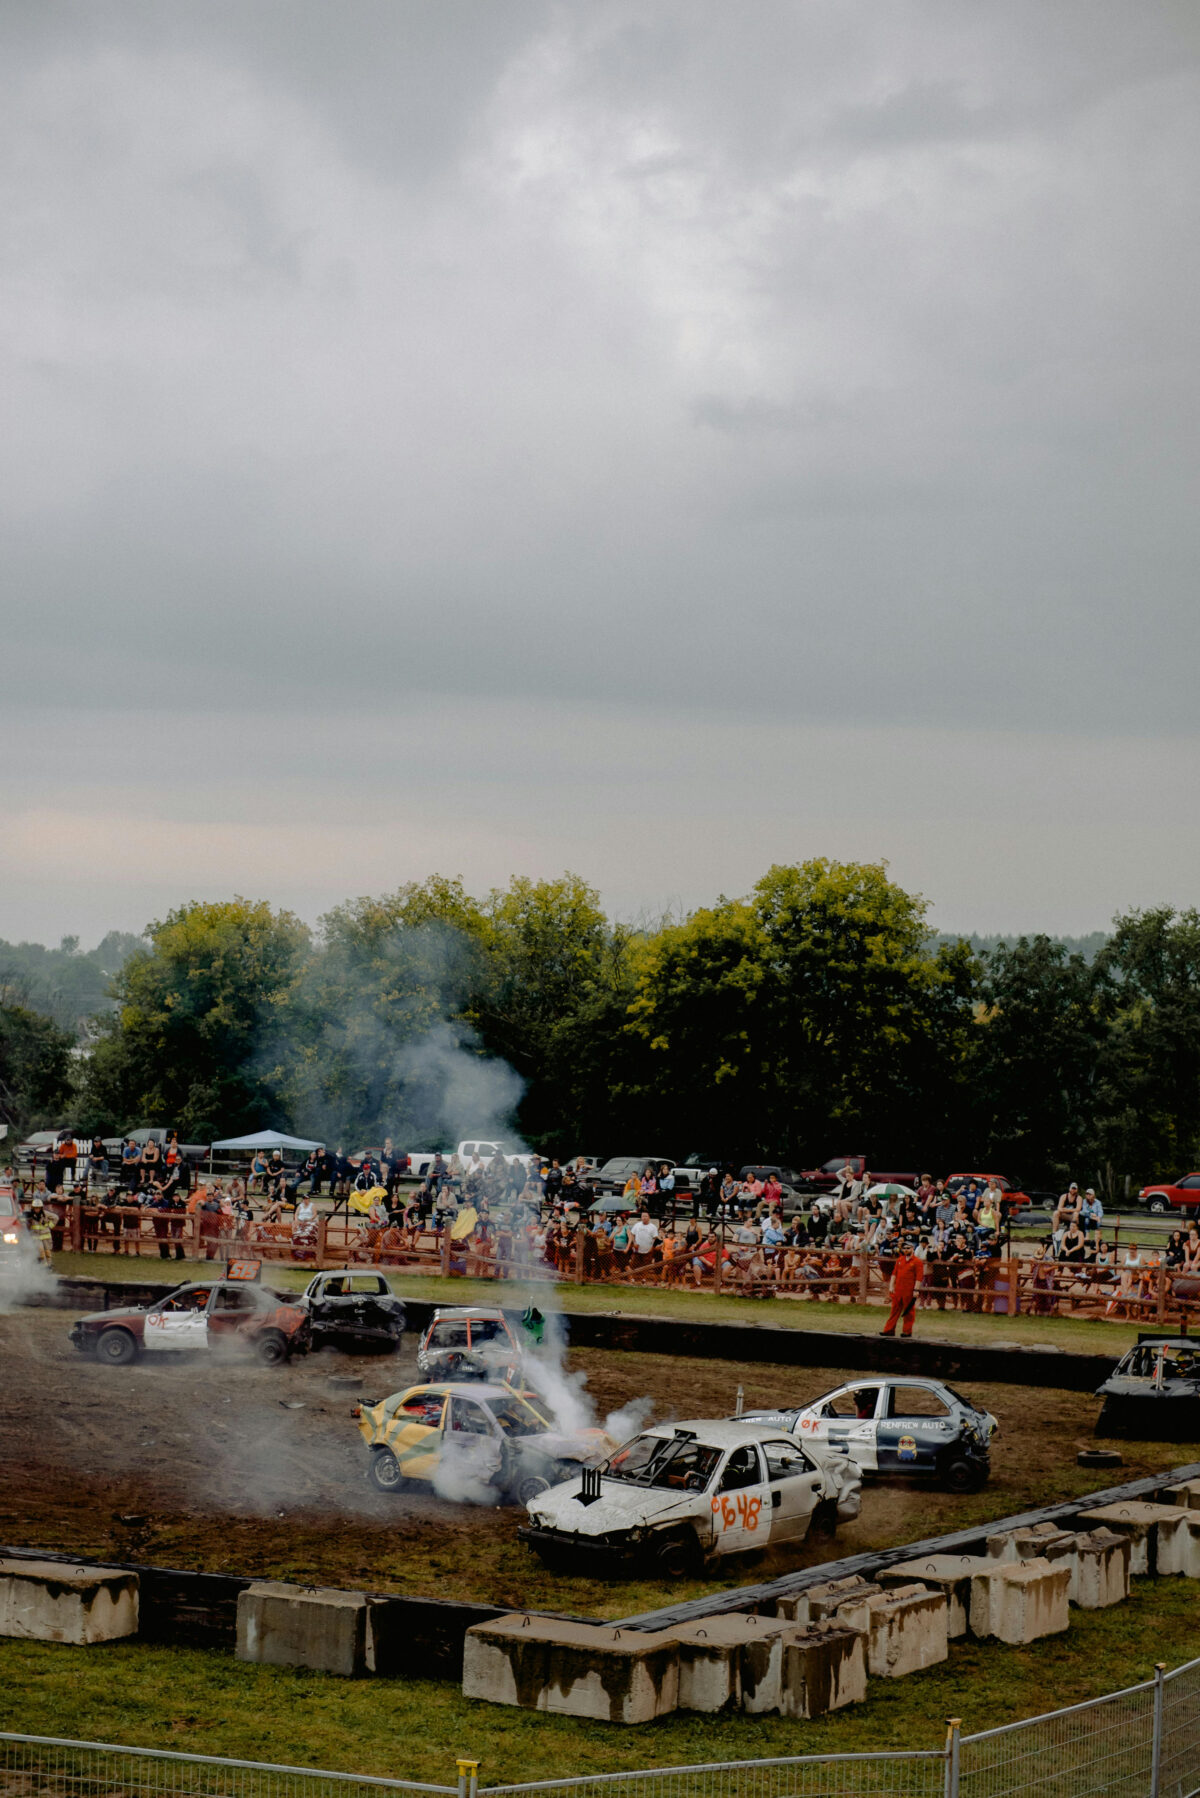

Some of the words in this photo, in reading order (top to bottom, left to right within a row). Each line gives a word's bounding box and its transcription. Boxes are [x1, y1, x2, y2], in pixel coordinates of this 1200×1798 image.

[147, 1314, 169, 1329] OK
[801, 1419, 821, 1433] OK
[880, 1421, 919, 1430] RENFREW
[921, 1421, 946, 1430] AUTO
